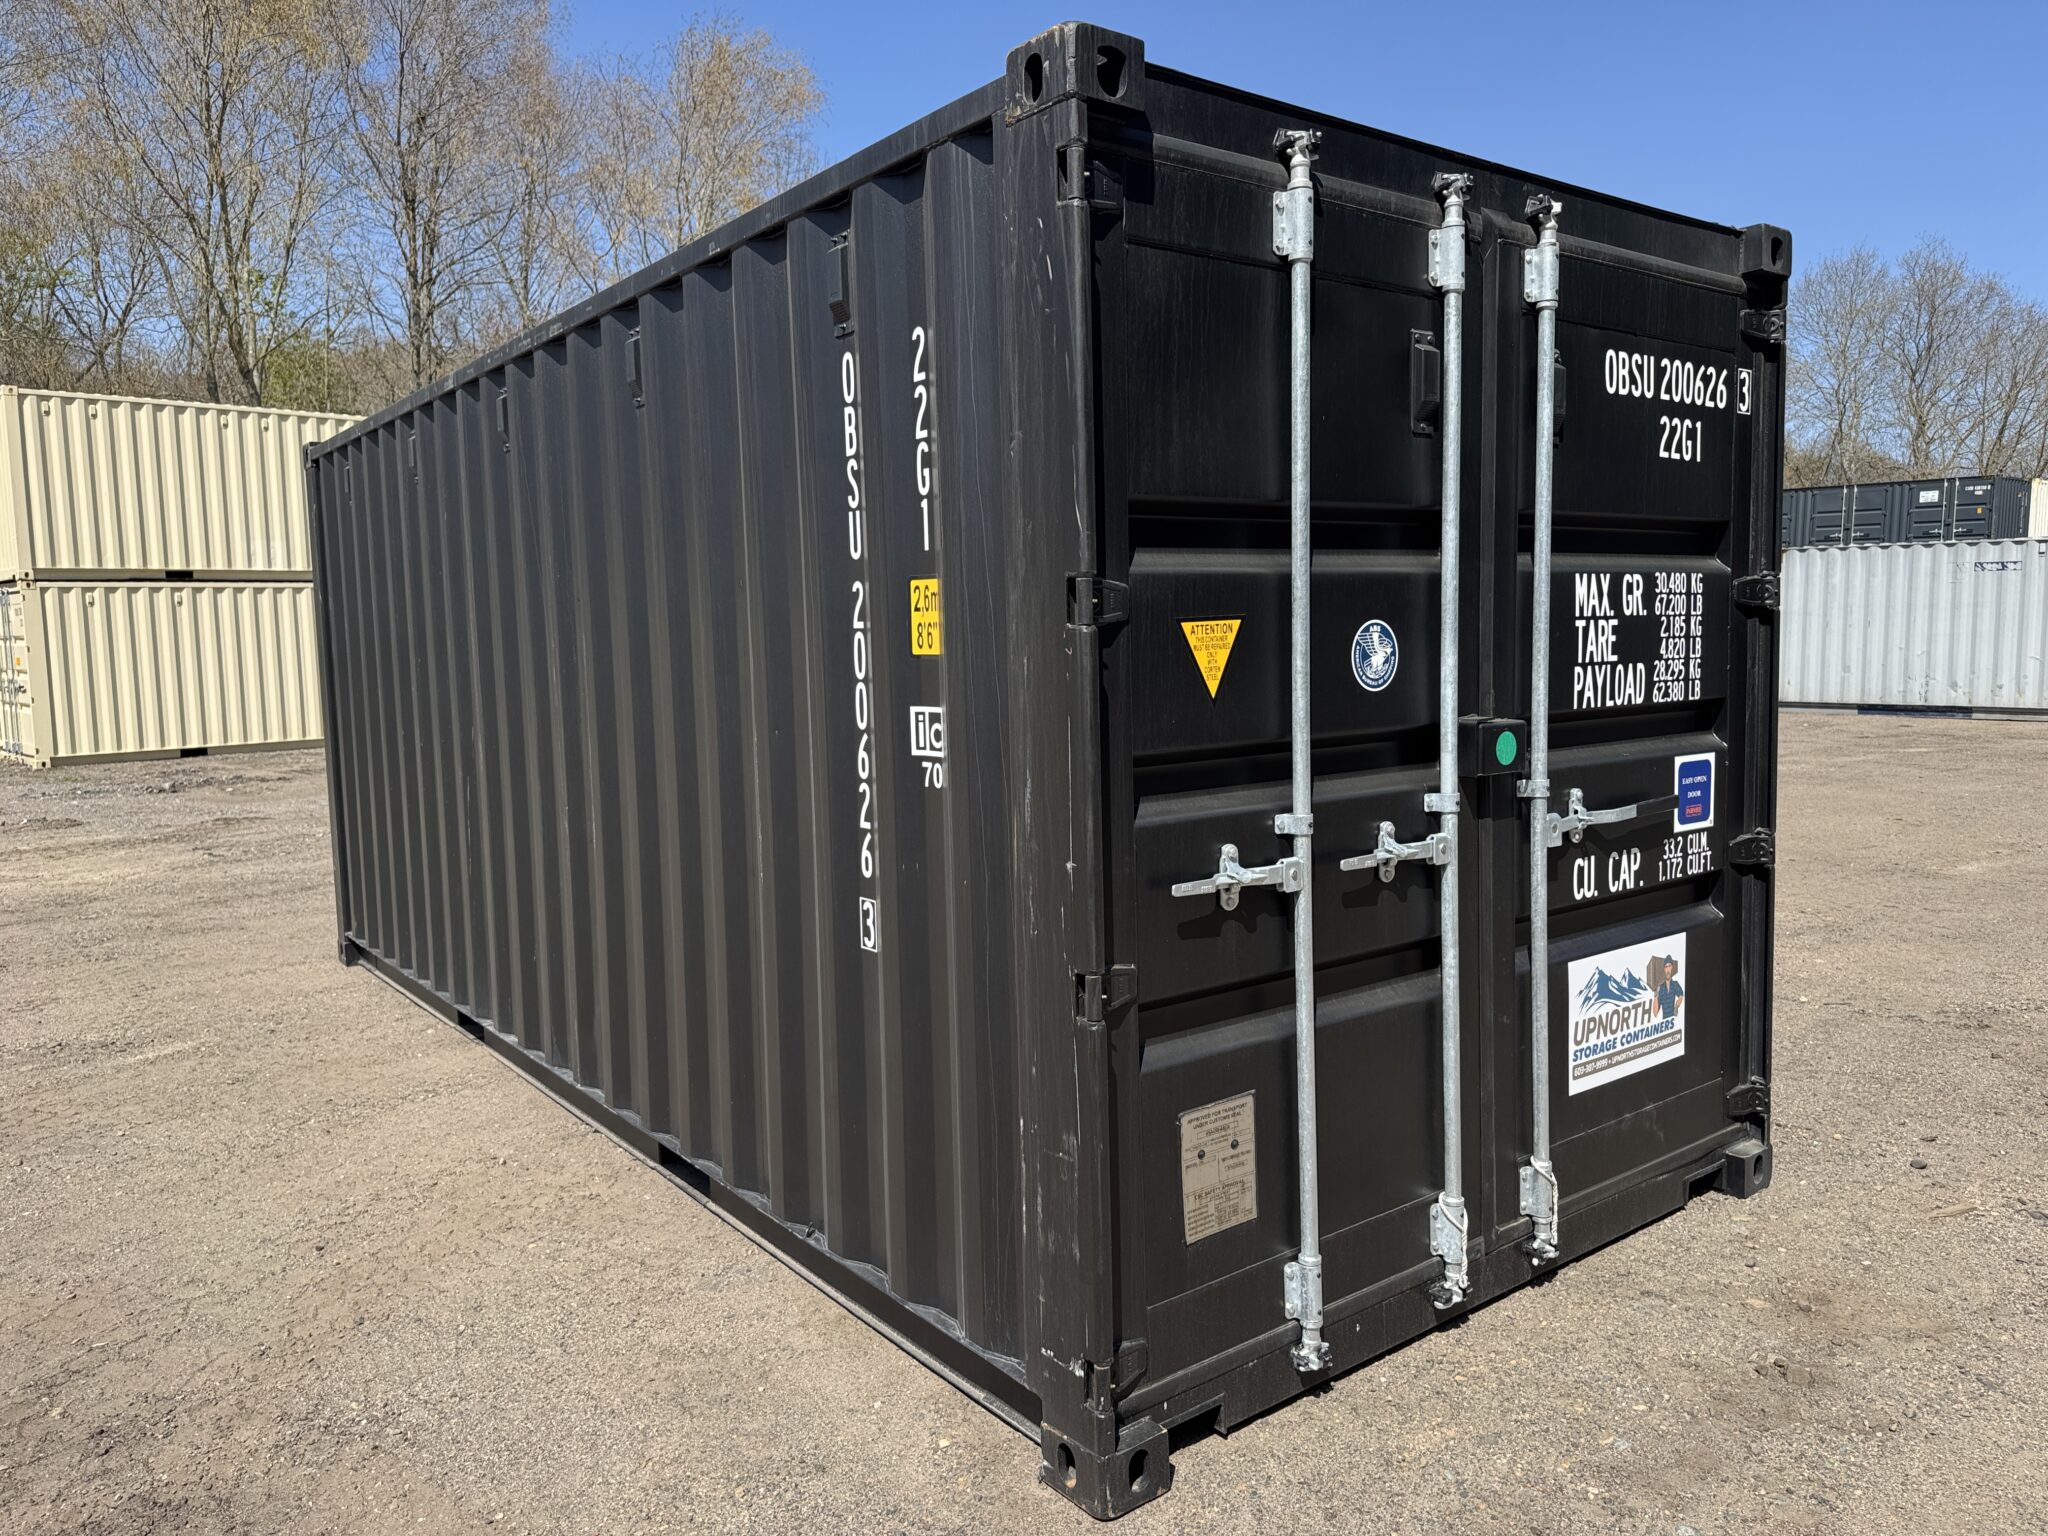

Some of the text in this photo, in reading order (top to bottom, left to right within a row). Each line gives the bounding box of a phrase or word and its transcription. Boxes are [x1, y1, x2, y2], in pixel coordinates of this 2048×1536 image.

[1605, 348, 1750, 412] OBSU 200626 3
[912, 326, 931, 551] 22G1
[1659, 415, 1702, 463] 22G1
[1575, 573, 1614, 617] MAX.
[1622, 573, 1647, 616] GR.
[1691, 572, 1703, 594] KG
[1691, 594, 1703, 615] LB
[842, 351, 875, 948] OBSU 200626 3
[1190, 623, 1233, 636] ATTENTION
[1575, 619, 1618, 663] TARE
[1690, 616, 1702, 637] KG
[1690, 638, 1701, 658] LB
[1573, 662, 1646, 710] PAYLOAD
[1689, 659, 1701, 680] KG
[1689, 680, 1700, 700] LB
[922, 761, 943, 789] 70
[1573, 831, 1709, 900] CU. CAP. 33.2 CU.M.
[1687, 851, 1714, 875] CU.FT.
[1572, 1018, 1675, 1062] STORAGE CONTAINERS
[1574, 998, 1653, 1047] UPNORTH
